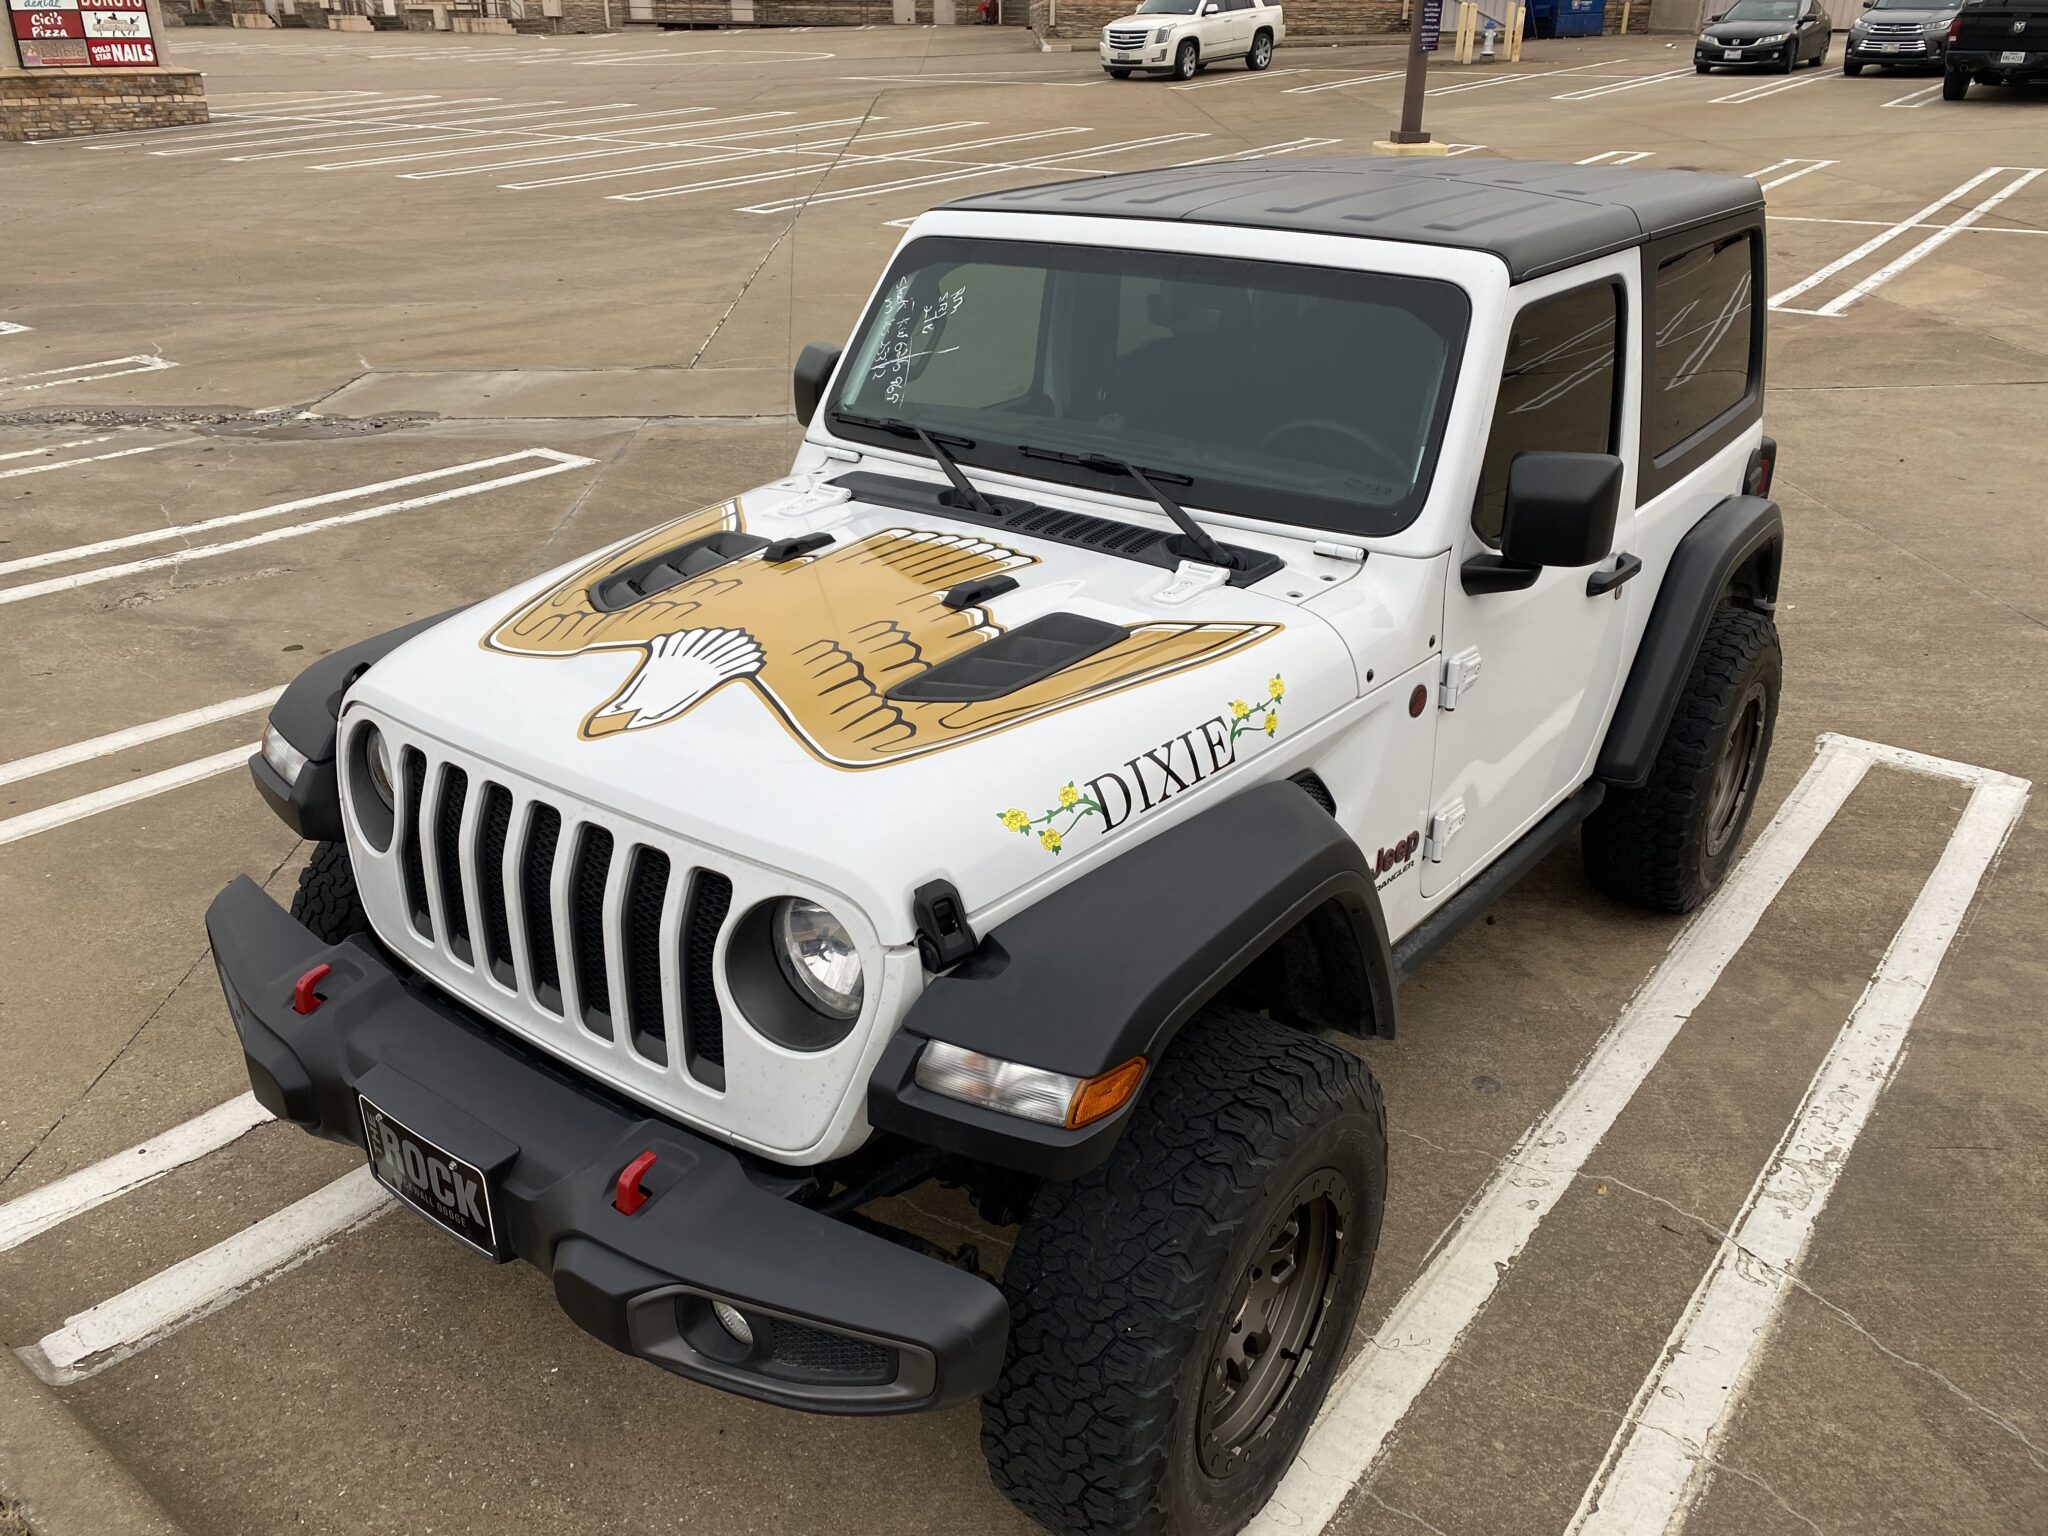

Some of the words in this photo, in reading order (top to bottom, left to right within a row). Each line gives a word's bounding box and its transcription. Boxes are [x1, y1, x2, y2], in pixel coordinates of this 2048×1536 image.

[91, 45, 111, 54] GOLD
[94, 52, 112, 62] STAR
[110, 43, 154, 62] NAILS
[1084, 715, 1236, 834] DIXIE
[1370, 830, 1420, 881] Jeep
[1376, 860, 1415, 892] RANGLER
[366, 1111, 383, 1155] THE
[378, 1121, 486, 1228] ROCK
[436, 1202, 467, 1228] DODGE
